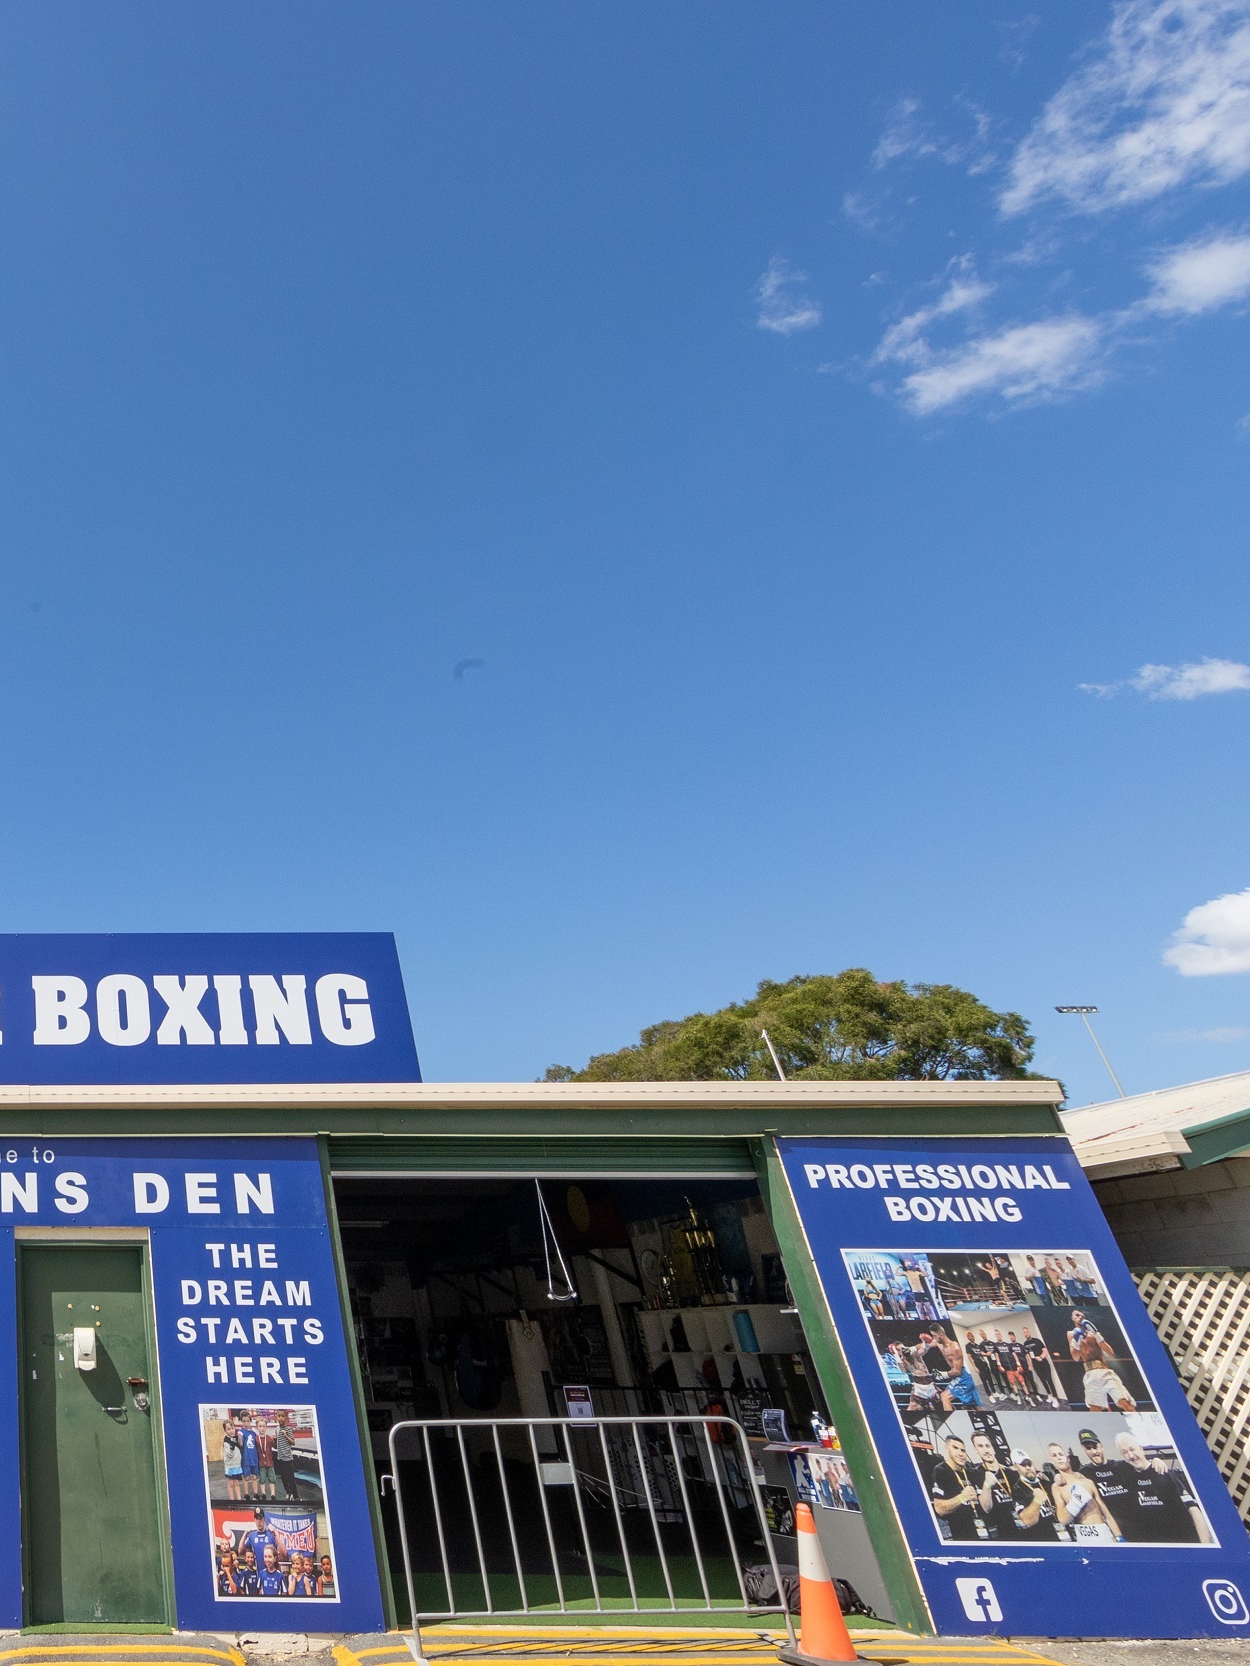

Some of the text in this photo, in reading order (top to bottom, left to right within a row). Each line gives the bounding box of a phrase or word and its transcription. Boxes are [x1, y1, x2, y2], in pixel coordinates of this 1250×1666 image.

[31, 973, 376, 1047] BOXING
[32, 1146, 55, 1164] to
[803, 1163, 1070, 1190] PROFESSIONAL
[132, 1172, 275, 1214] DEN
[883, 1196, 1023, 1223] BOXING
[205, 1243, 279, 1269] THE
[180, 1279, 312, 1306] DREAM
[176, 1316, 324, 1345] STARTS
[205, 1356, 309, 1384] HERE
[1077, 1526, 1099, 1537] VEGAS
